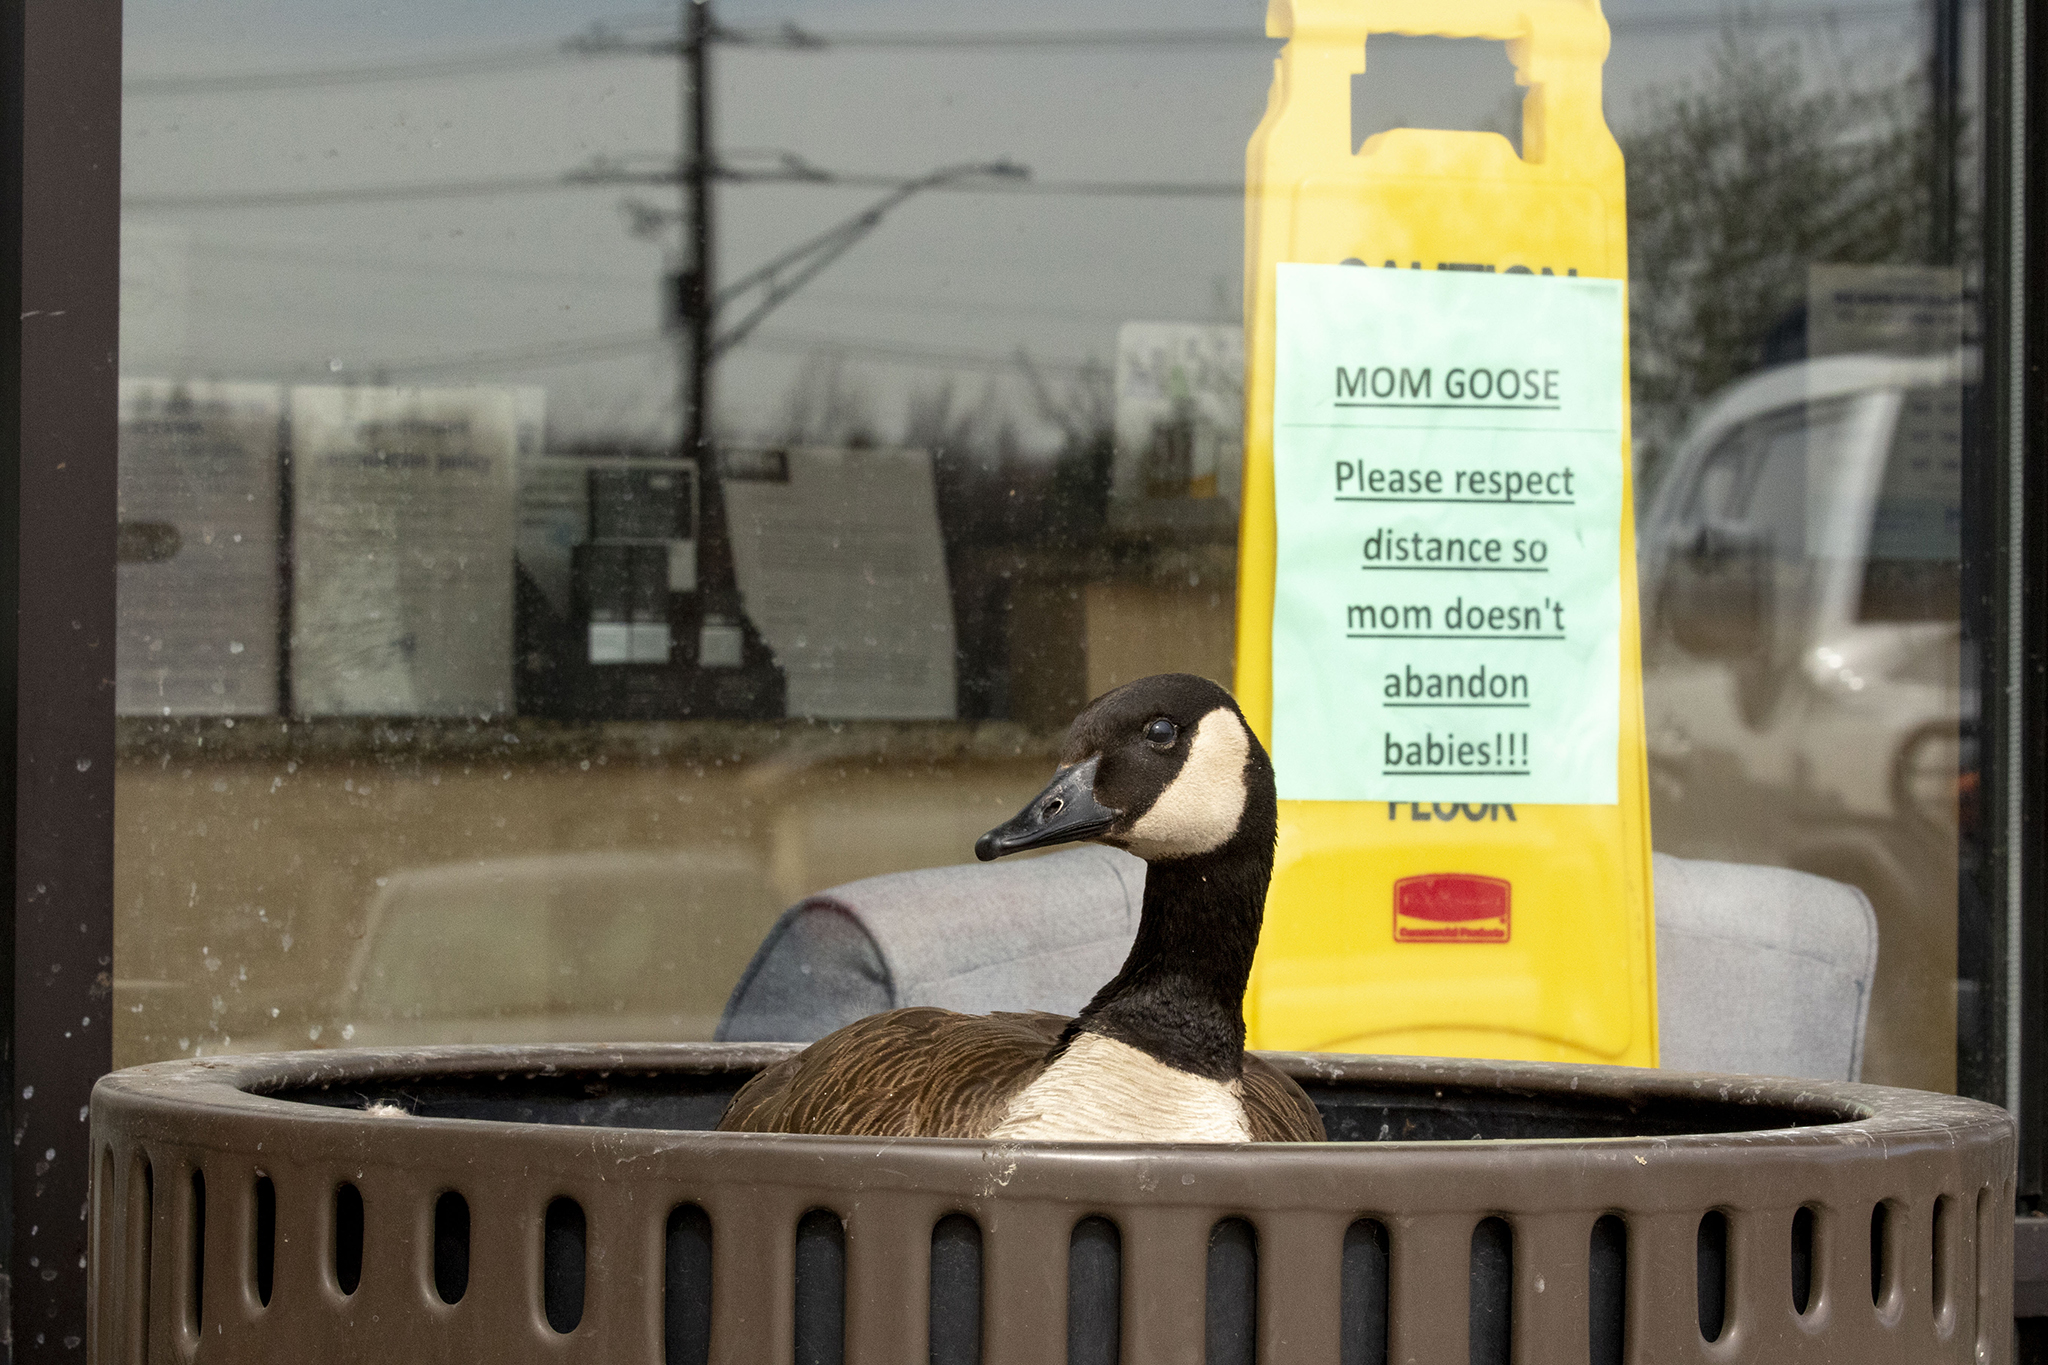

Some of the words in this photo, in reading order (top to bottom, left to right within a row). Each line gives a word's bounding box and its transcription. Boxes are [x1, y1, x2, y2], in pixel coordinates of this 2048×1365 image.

[1335, 366, 1431, 398] MOM
[1445, 369, 1560, 400] GOOSE
[1335, 459, 1443, 494] Please
[1455, 466, 1575, 502] respect
[1363, 528, 1502, 562] distance
[1513, 540, 1548, 563] so
[1347, 603, 1432, 630] mom
[1445, 597, 1565, 631] doesn't
[1384, 664, 1528, 698] abandon
[1384, 731, 1528, 766] babies!!!
